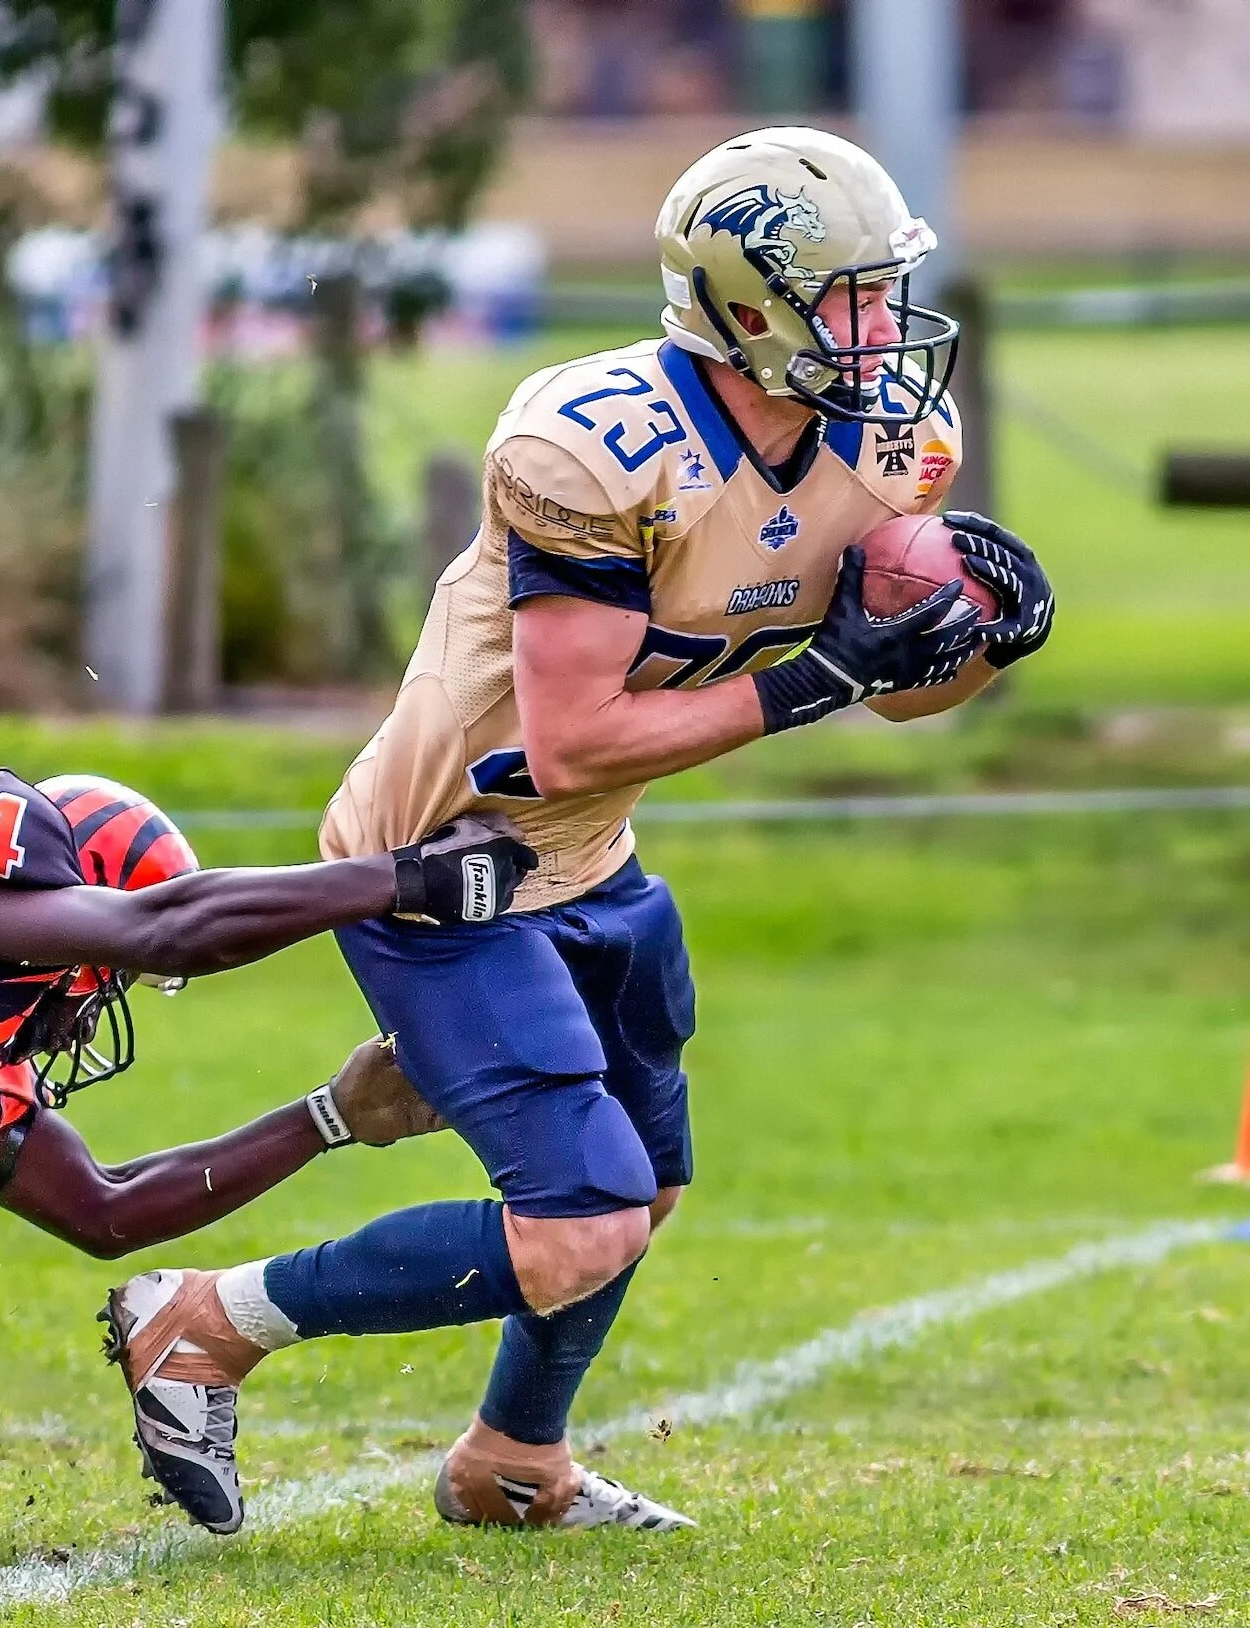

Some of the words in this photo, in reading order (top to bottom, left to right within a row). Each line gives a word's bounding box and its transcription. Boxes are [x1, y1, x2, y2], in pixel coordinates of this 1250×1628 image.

[556, 367, 689, 474] 23
[468, 859, 490, 919] Franklin
[311, 1094, 342, 1138] Franklin
